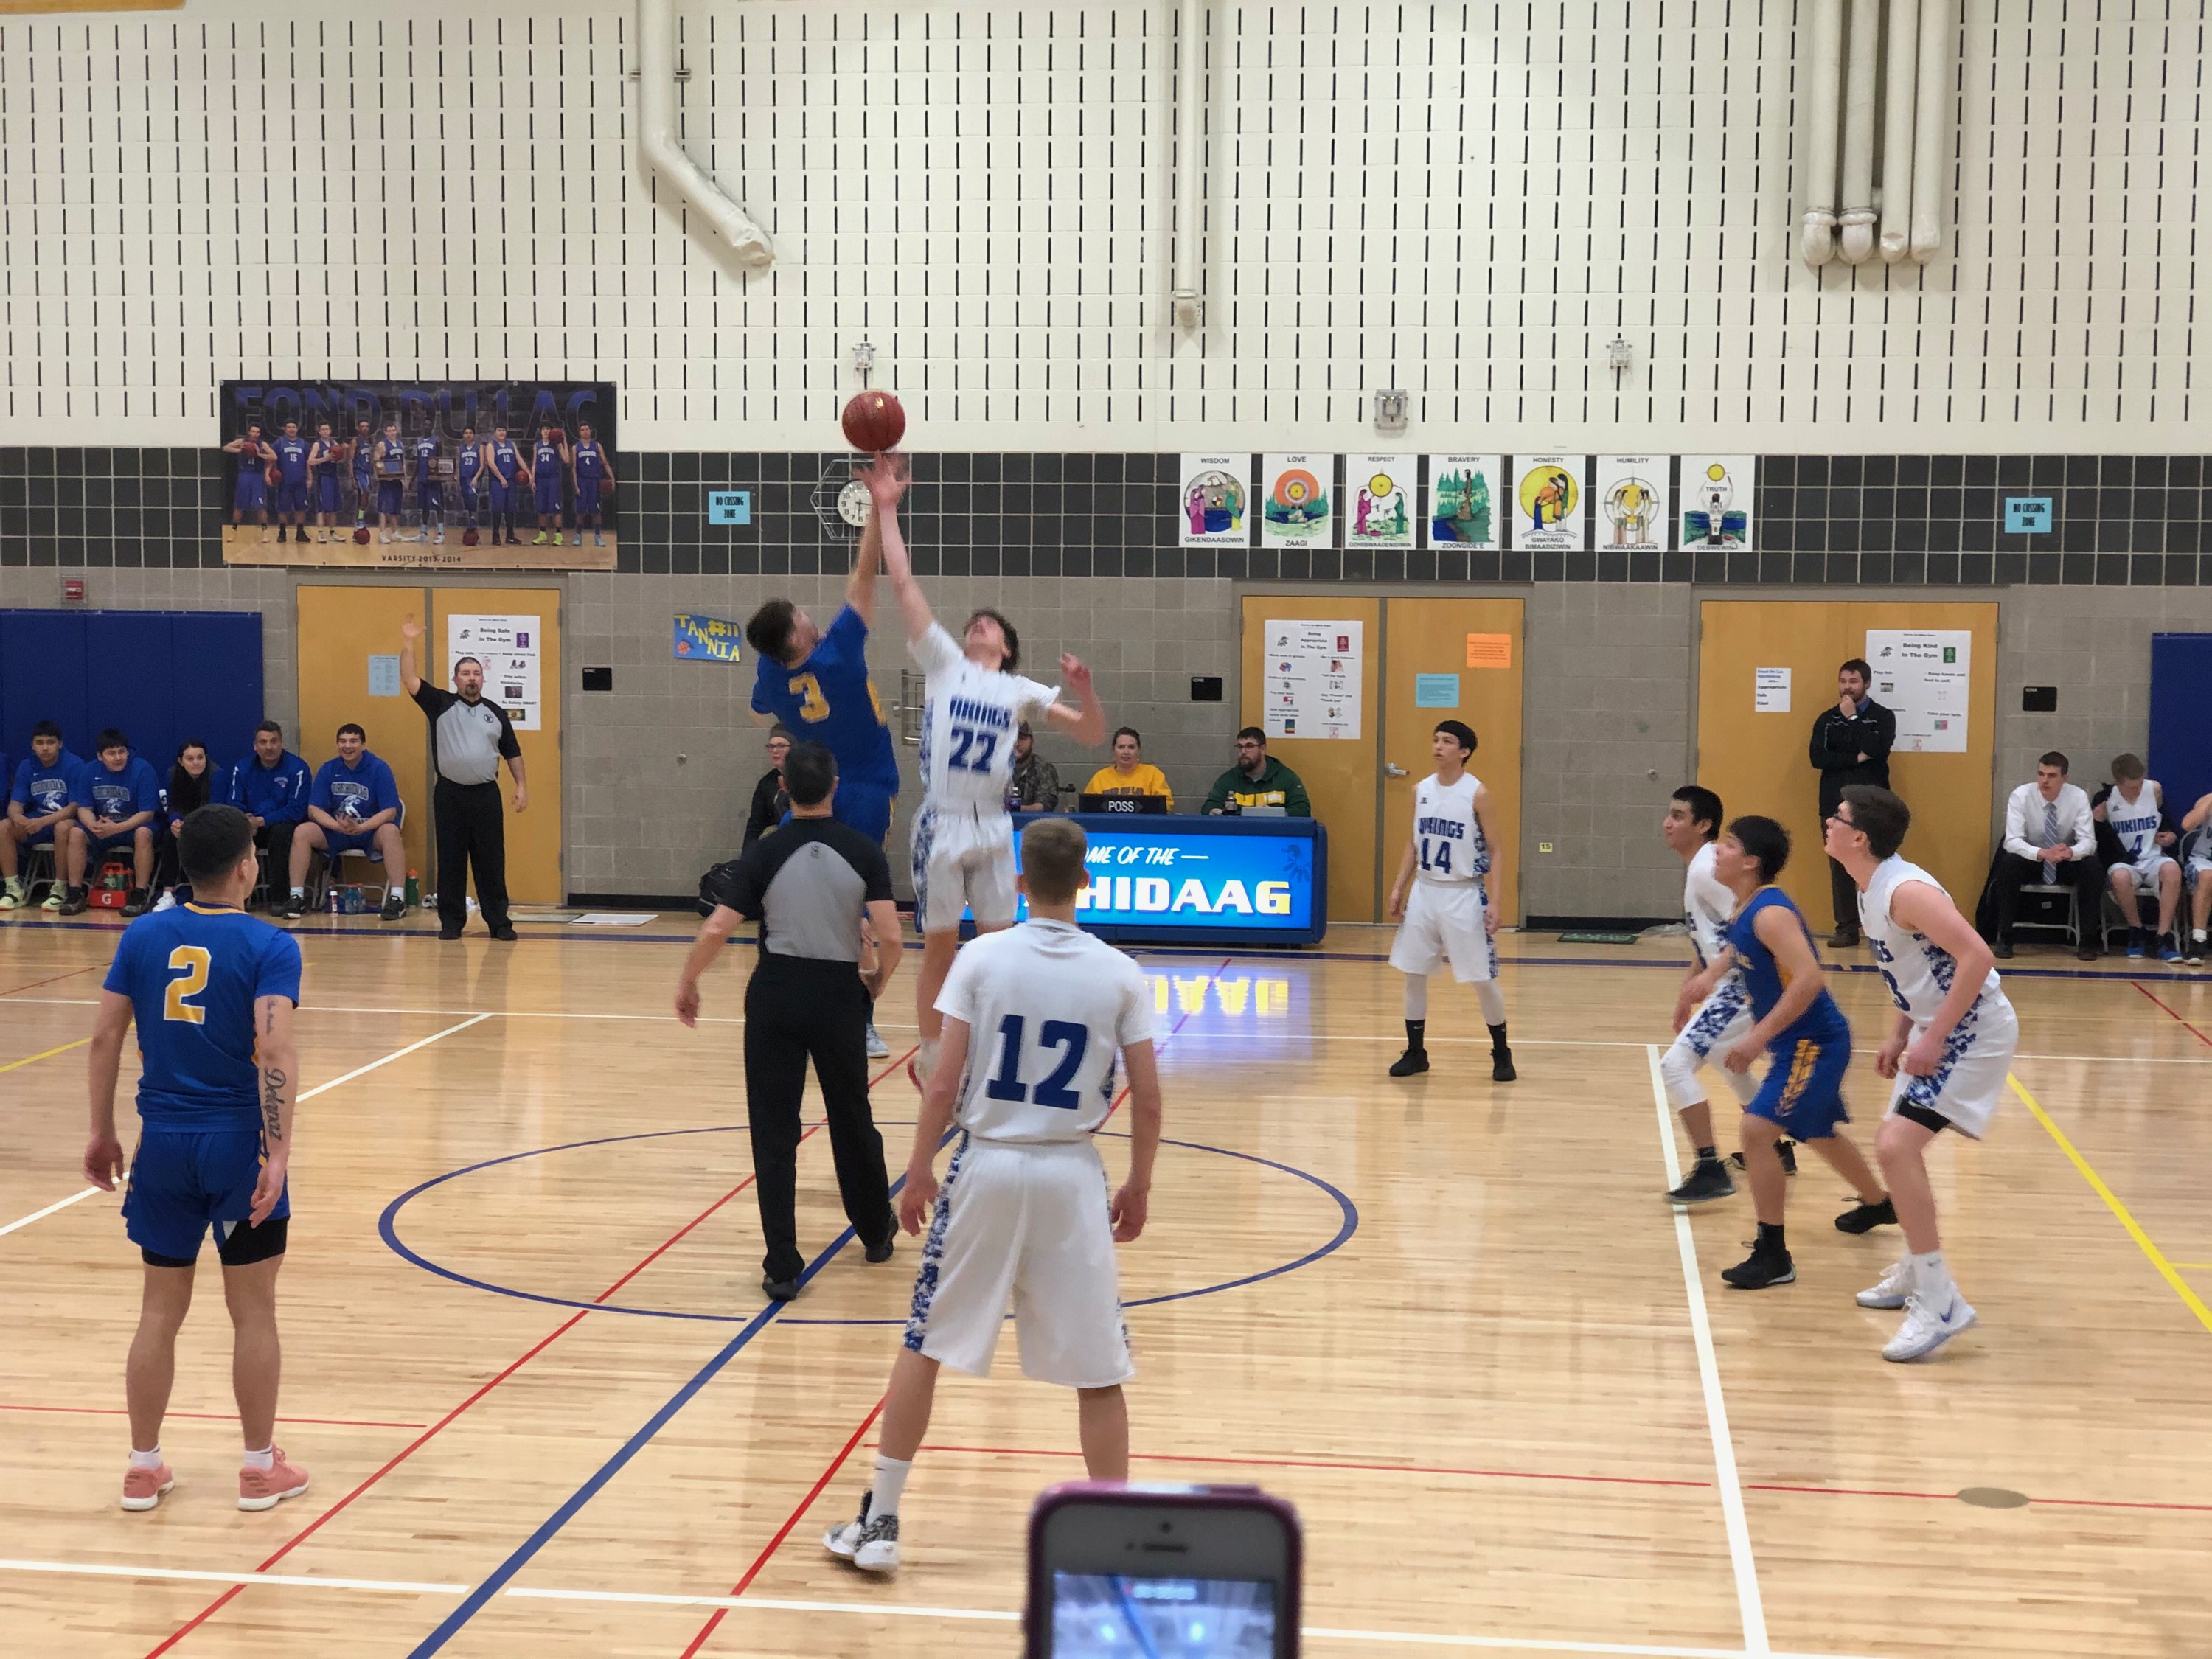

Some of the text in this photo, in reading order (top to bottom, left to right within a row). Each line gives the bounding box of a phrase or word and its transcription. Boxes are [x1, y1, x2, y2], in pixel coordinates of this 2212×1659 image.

[235, 387, 597, 439] FOND DU LAC
[421, 449, 428, 457] 12
[716, 496, 744, 506] NO CUSSING
[672, 615, 740, 661] TANNIA
[789, 672, 830, 723] 3
[948, 728, 998, 773] 22
[1108, 801, 1135, 813] POSS
[2112, 815, 2157, 834] VIKINGS
[1418, 817, 1466, 840] VIKINGS
[1084, 846, 1180, 866] ME OF THE
[1420, 838, 1452, 874] 14
[102, 893, 112, 905] G
[1074, 876, 1291, 914] HIDAAG
[163, 945, 212, 1025] 2
[985, 1013, 1091, 1110] 12
